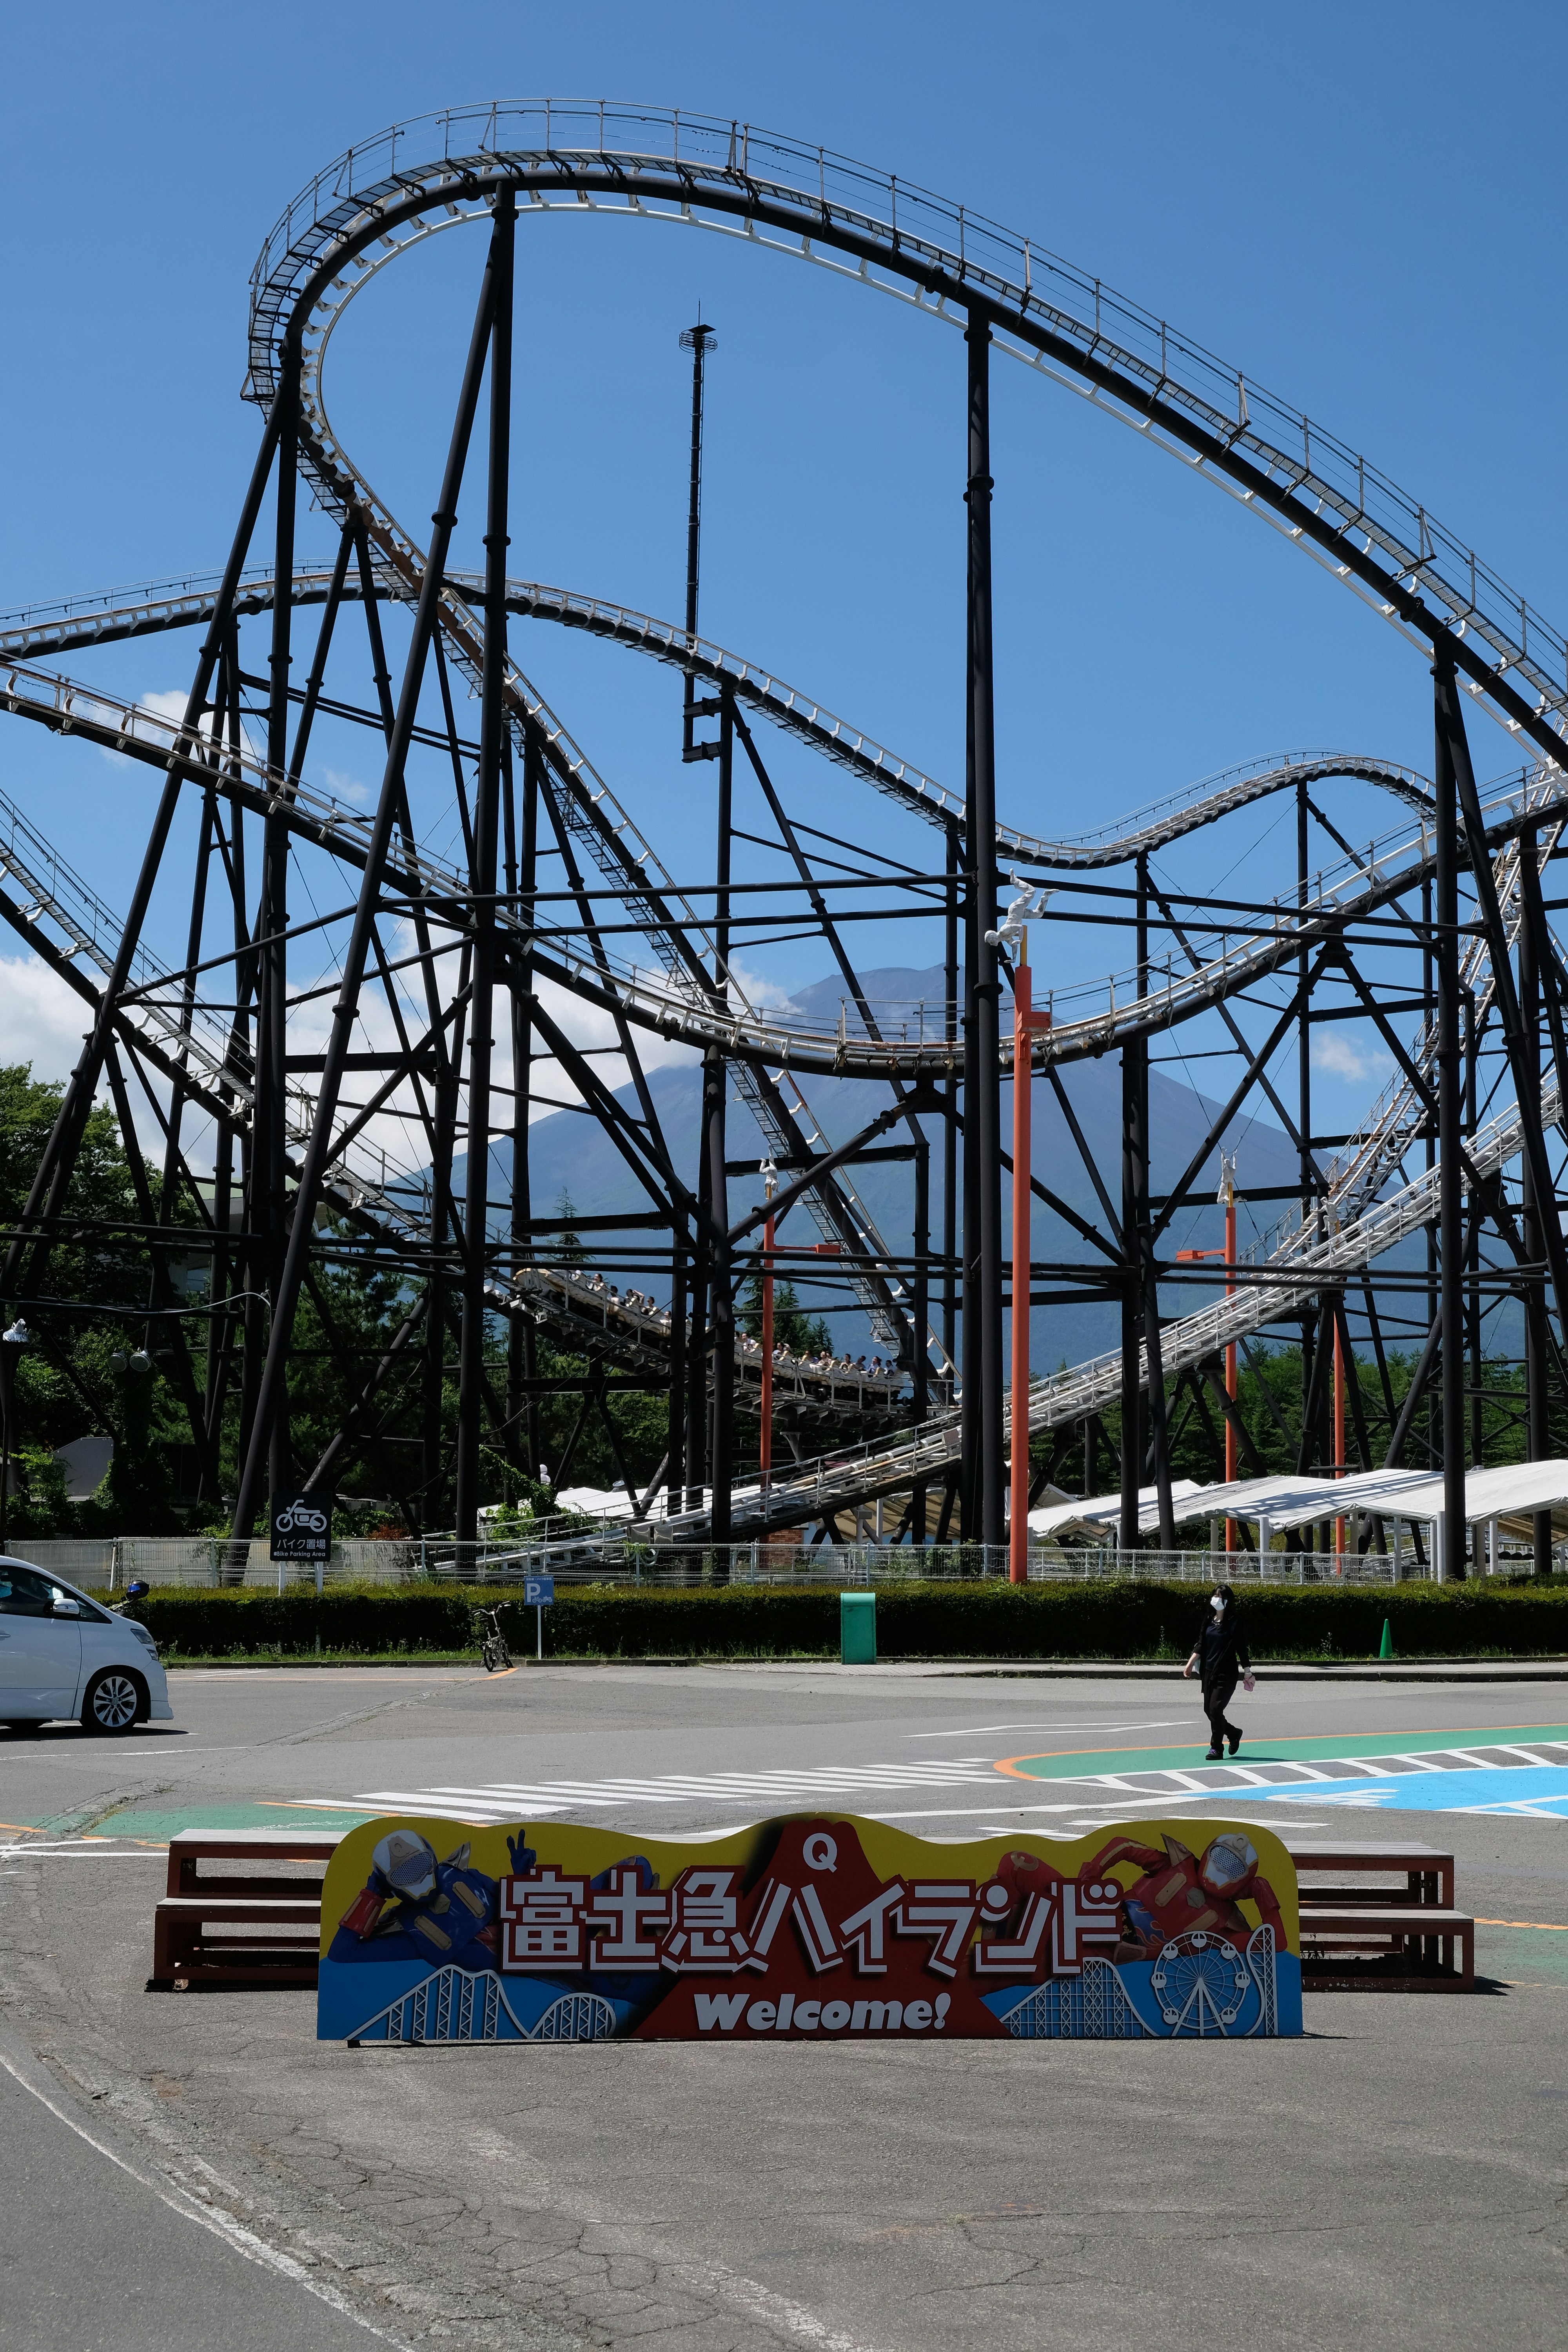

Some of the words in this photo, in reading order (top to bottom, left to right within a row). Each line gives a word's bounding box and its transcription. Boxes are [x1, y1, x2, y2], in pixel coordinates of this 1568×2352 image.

[277, 1539, 325, 1549] バイク置場
[527, 1583, 541, 1602] P
[803, 1833, 837, 1873] Q
[510, 1870, 1120, 1963] 富士急ハイランド
[693, 1993, 951, 2030] Welcome!
